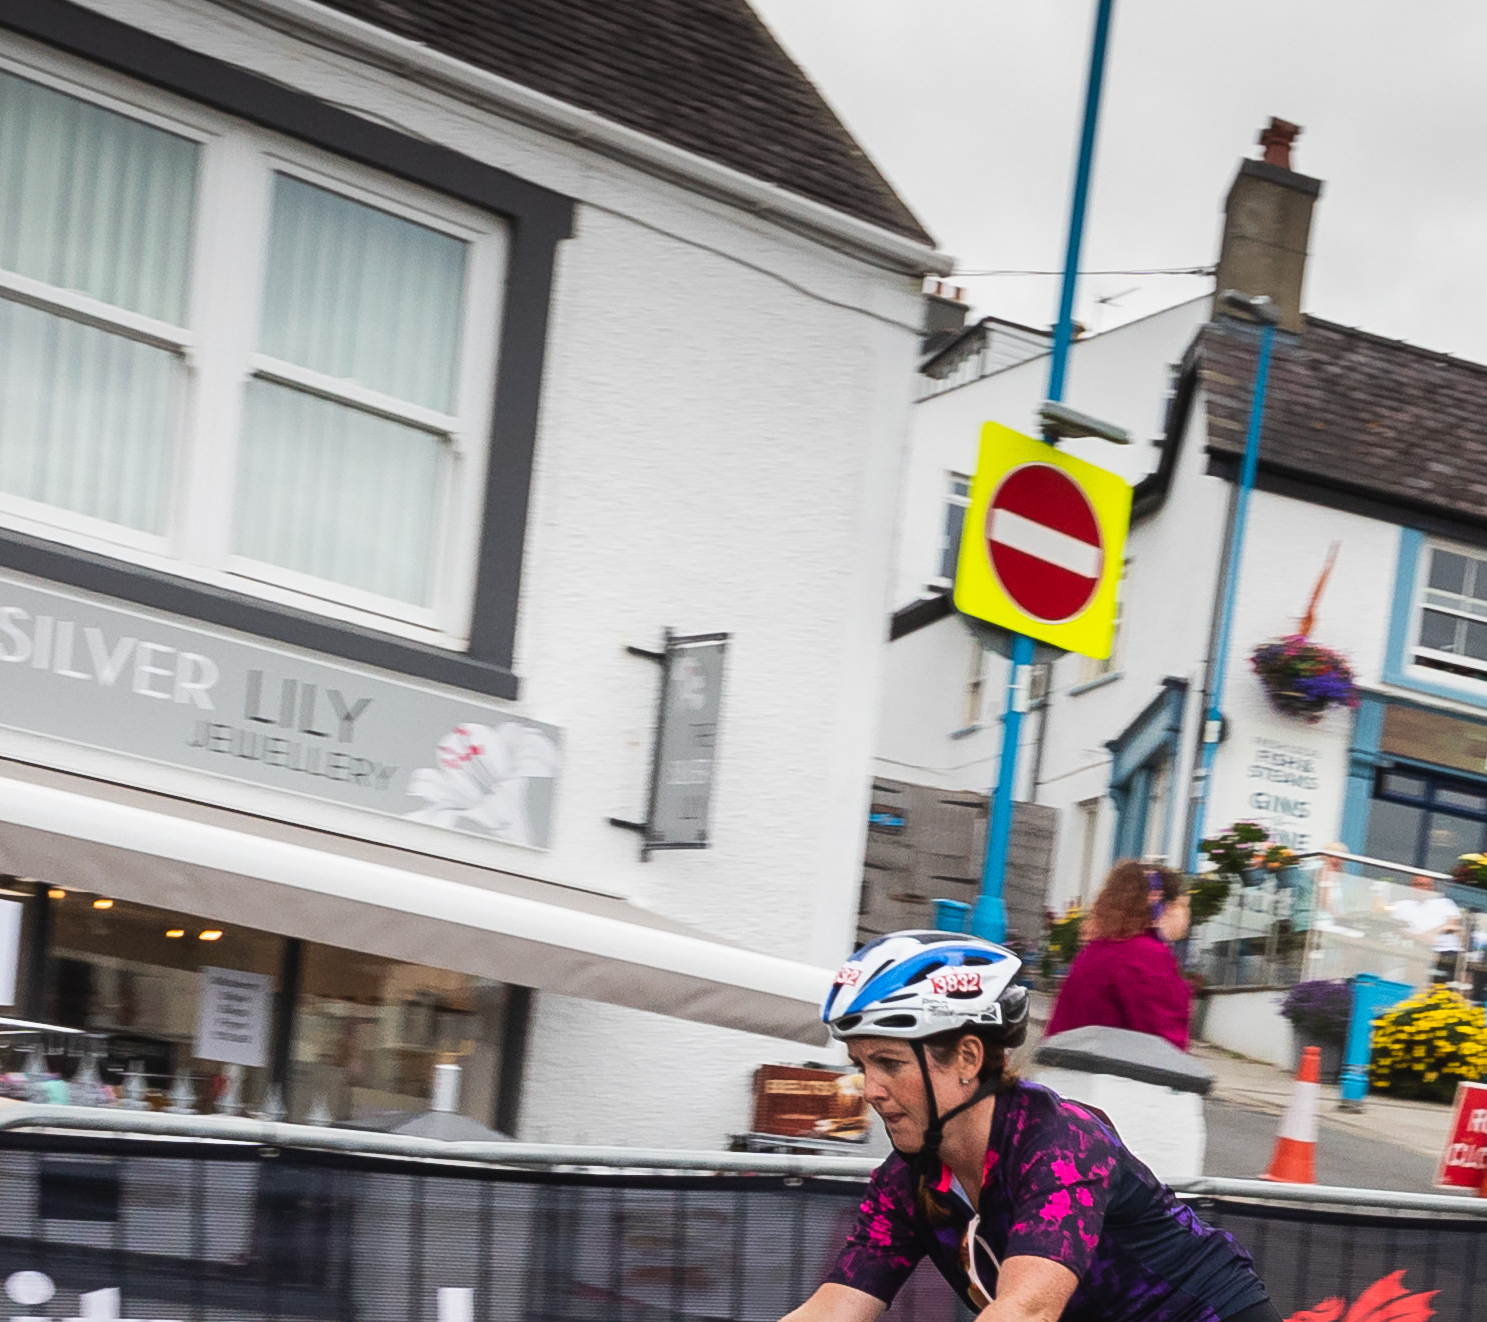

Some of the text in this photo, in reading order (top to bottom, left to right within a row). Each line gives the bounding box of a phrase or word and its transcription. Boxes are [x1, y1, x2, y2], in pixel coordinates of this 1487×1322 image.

[244, 669, 373, 745] LILY
[186, 719, 401, 793] JEWELLERY
[933, 972, 981, 994] 3832
